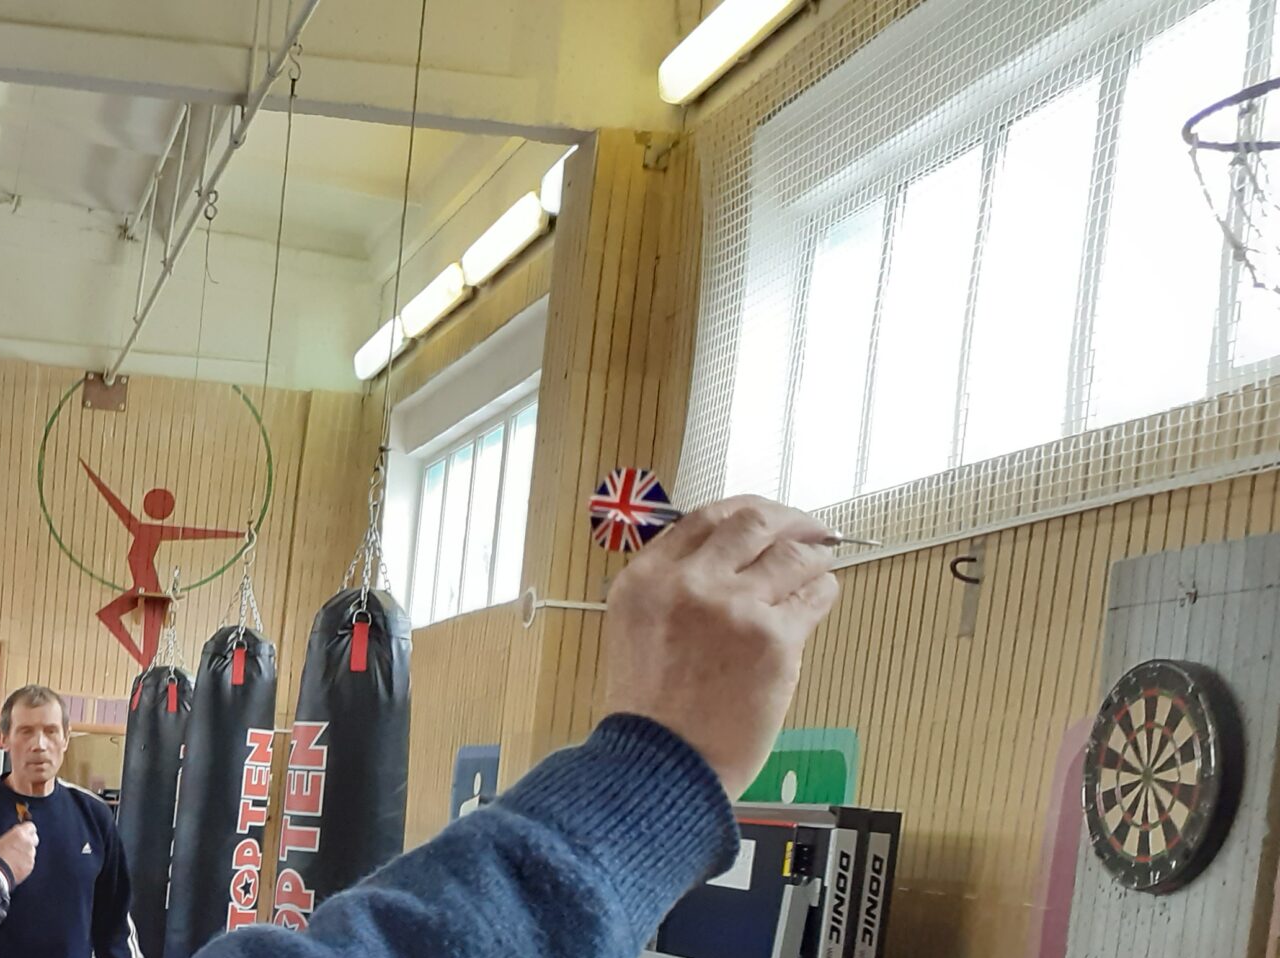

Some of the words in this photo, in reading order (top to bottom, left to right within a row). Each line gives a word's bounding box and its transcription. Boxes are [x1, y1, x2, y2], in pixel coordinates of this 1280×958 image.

[236, 728, 274, 834] TEN
[279, 721, 329, 861] TEN
[226, 838, 263, 934] TOP
[829, 850, 851, 944] DONIC
[861, 854, 884, 946] DONIC
